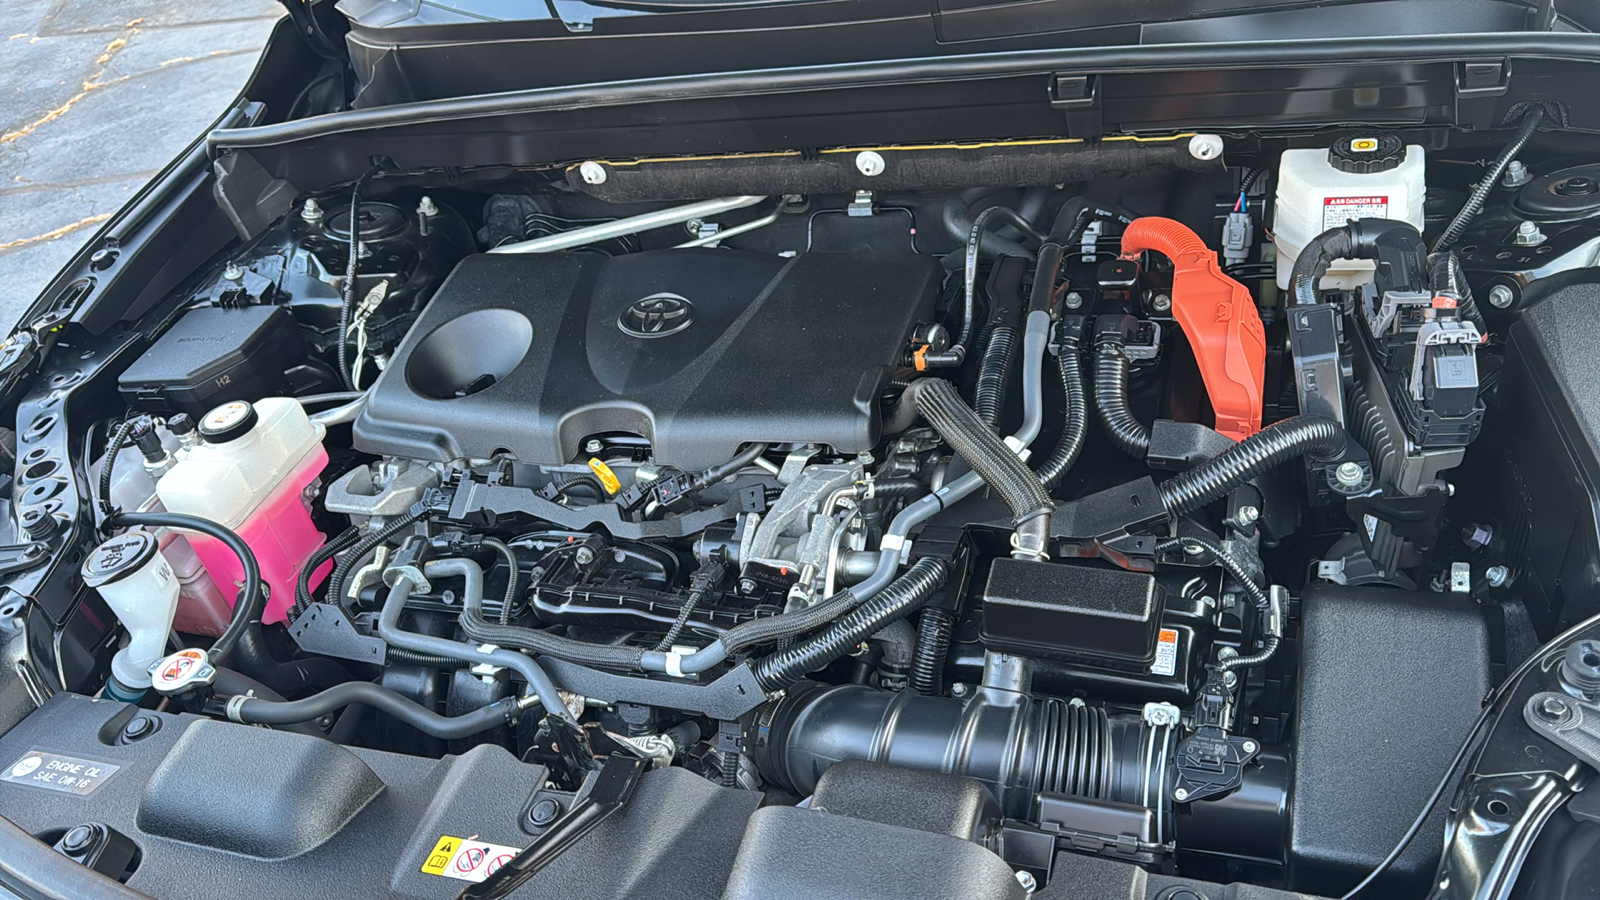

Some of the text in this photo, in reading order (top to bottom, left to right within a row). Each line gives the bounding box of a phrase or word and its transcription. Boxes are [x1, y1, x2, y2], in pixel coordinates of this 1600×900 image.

[215, 374, 231, 388] H2
[45, 760, 84, 774] ENGINE
[33, 771, 58, 783] SAE
